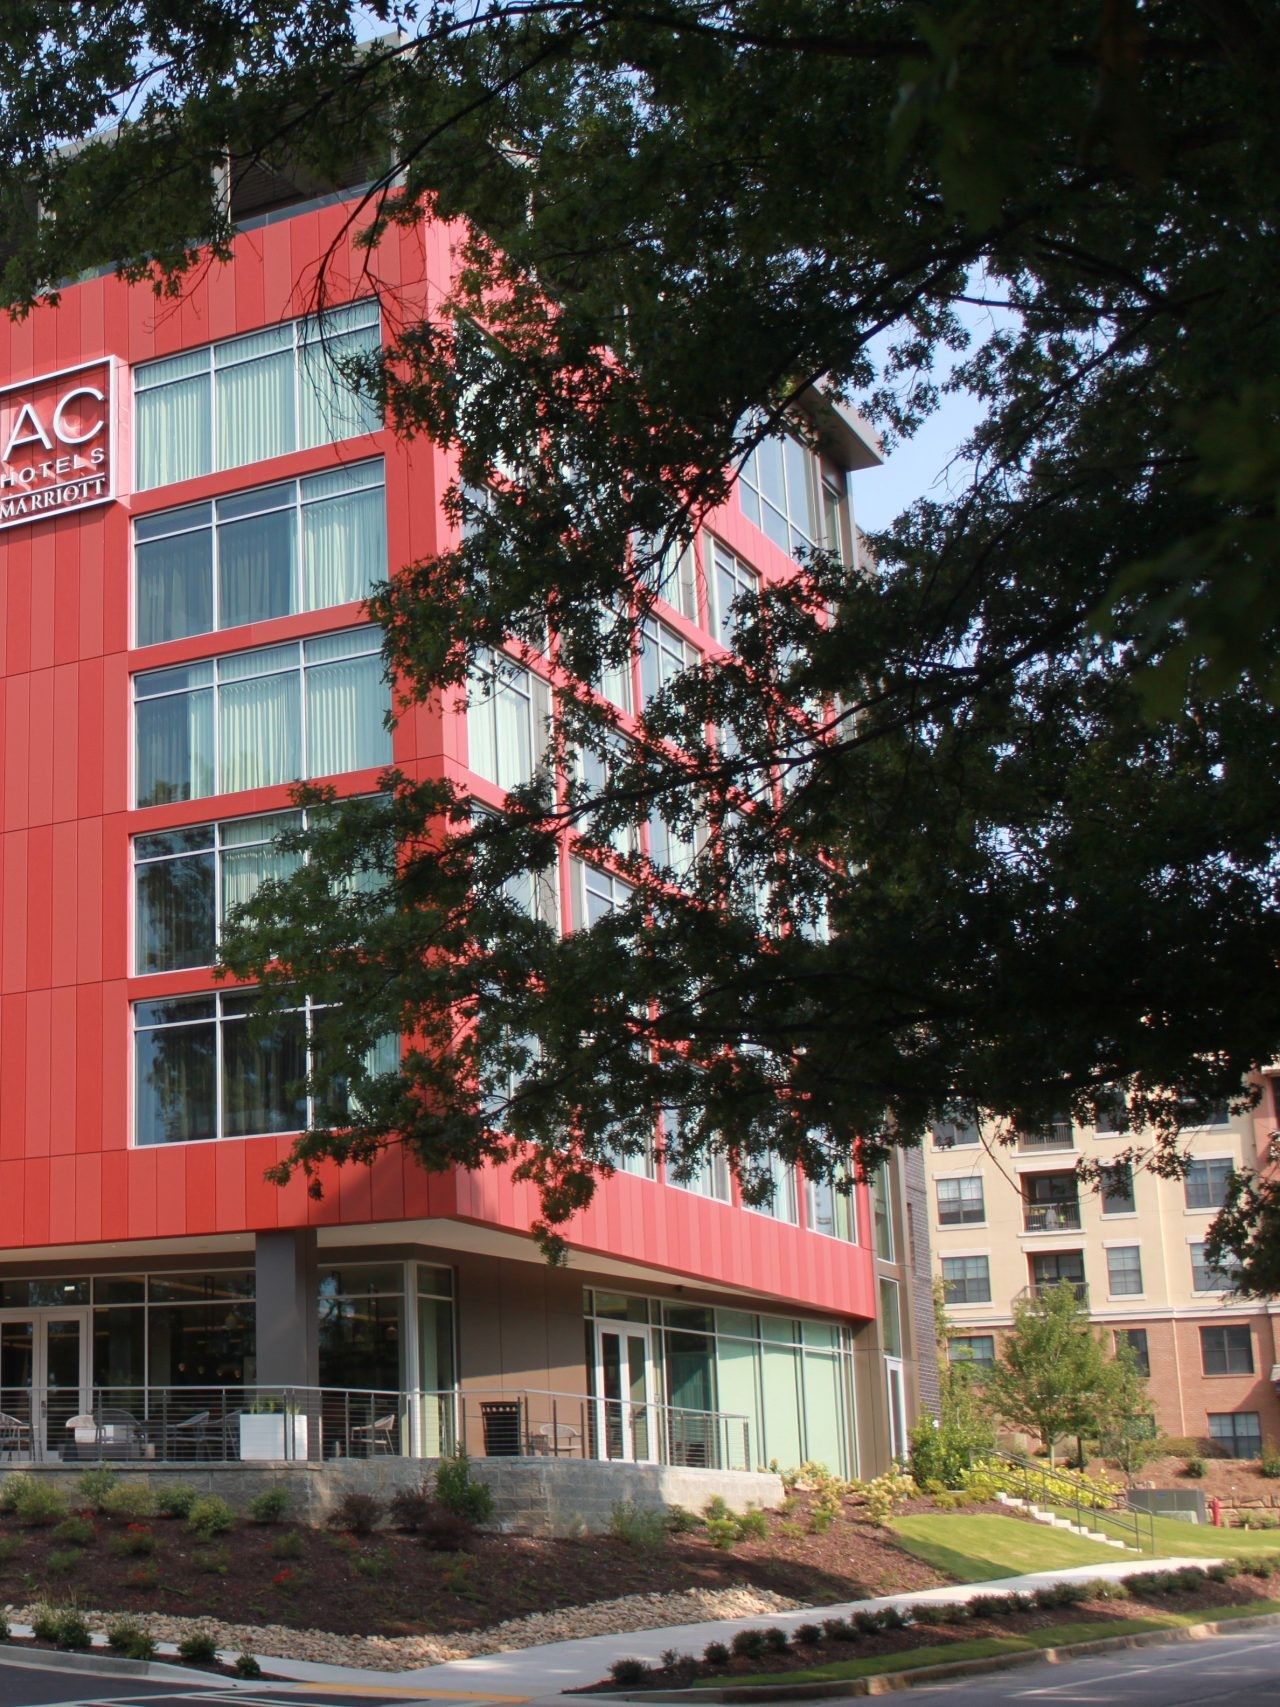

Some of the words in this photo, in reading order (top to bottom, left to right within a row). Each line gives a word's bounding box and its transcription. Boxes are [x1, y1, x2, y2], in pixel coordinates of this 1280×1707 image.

[2, 387, 105, 462] AC
[0, 447, 105, 489] HOTELS
[0, 477, 106, 519] MARRIOTT
